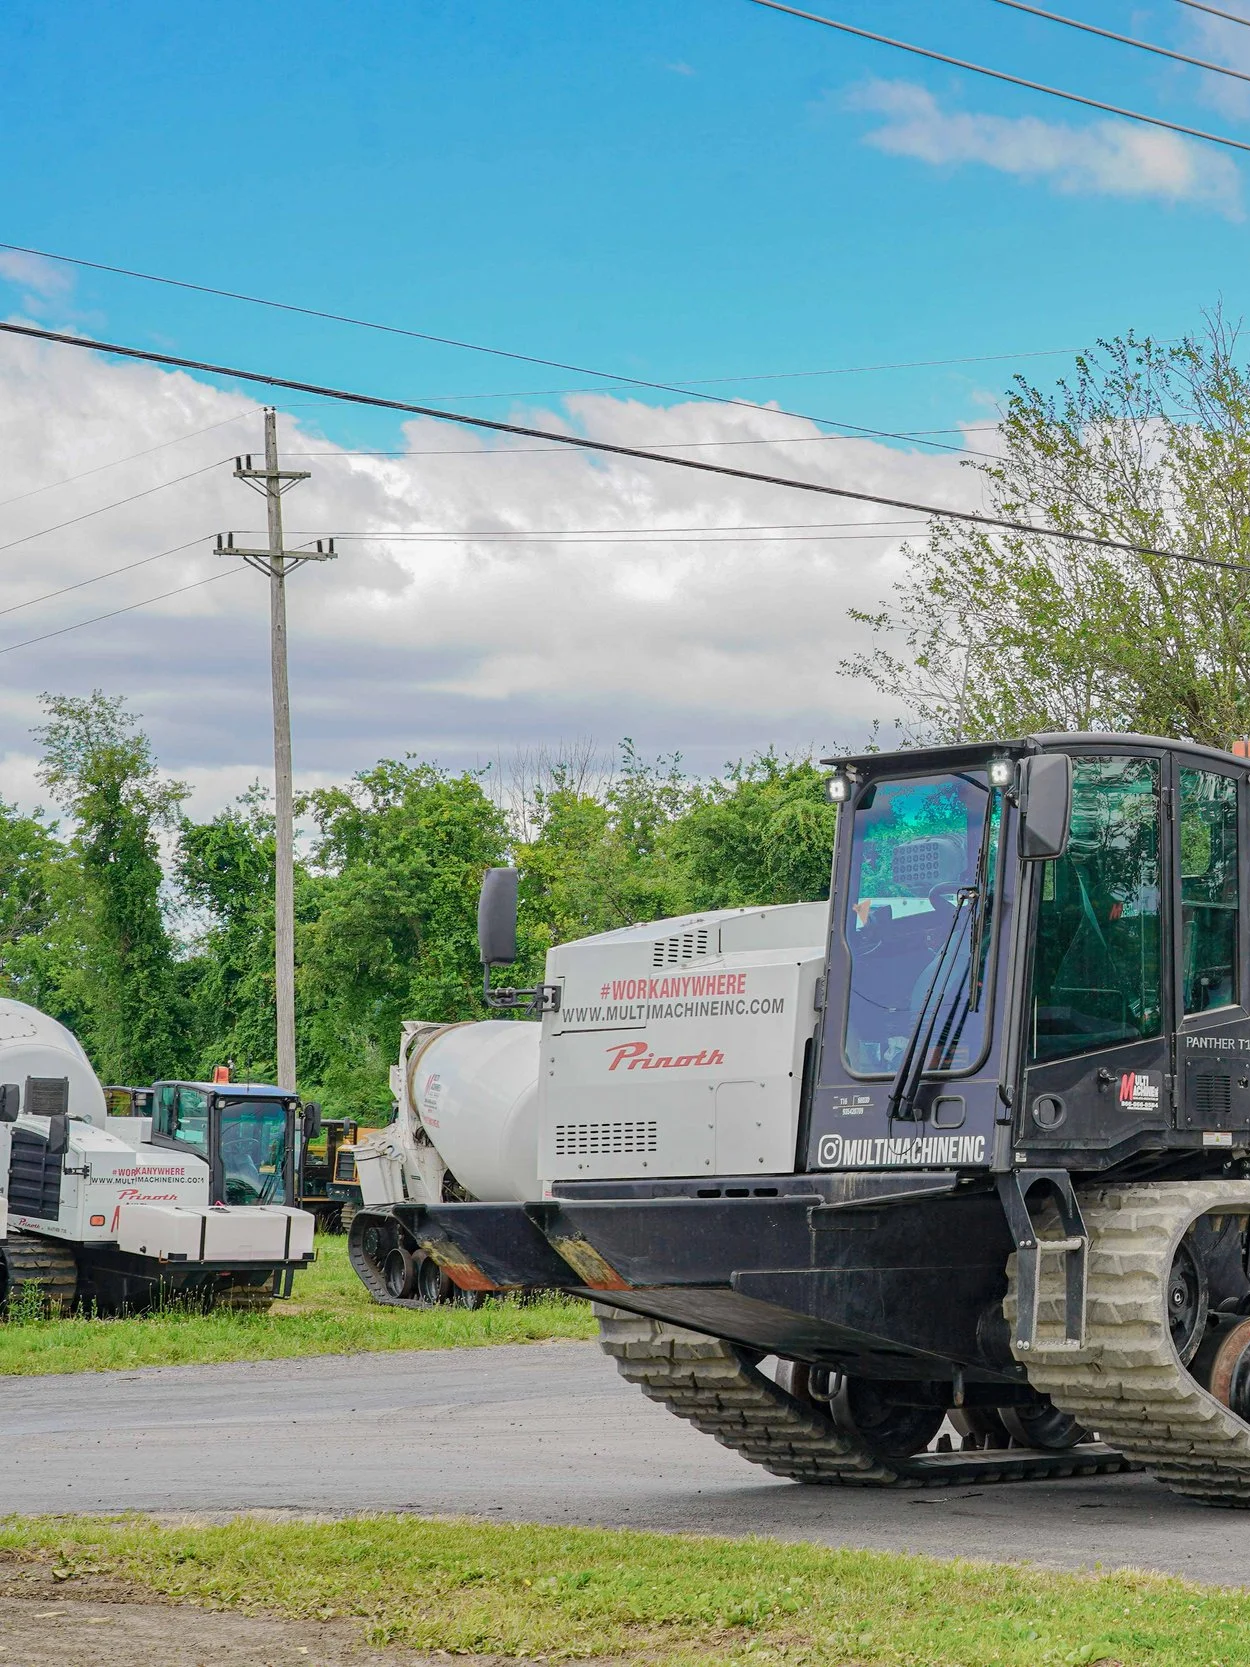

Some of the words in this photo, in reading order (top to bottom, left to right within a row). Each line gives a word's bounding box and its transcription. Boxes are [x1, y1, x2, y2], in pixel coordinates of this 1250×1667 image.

[600, 973, 747, 1000] #WORKANYWHERE
[562, 998, 784, 1023] WWW.MULTIMACHINEINC.COM
[1186, 1036, 1236, 1050] PANTHER
[606, 1041, 724, 1071] Prinoth
[842, 1135, 986, 1166] MULTIMACHINEINC
[112, 1167, 185, 1177] #WORKANYWHERE
[116, 1188, 179, 1201] Prinoth
